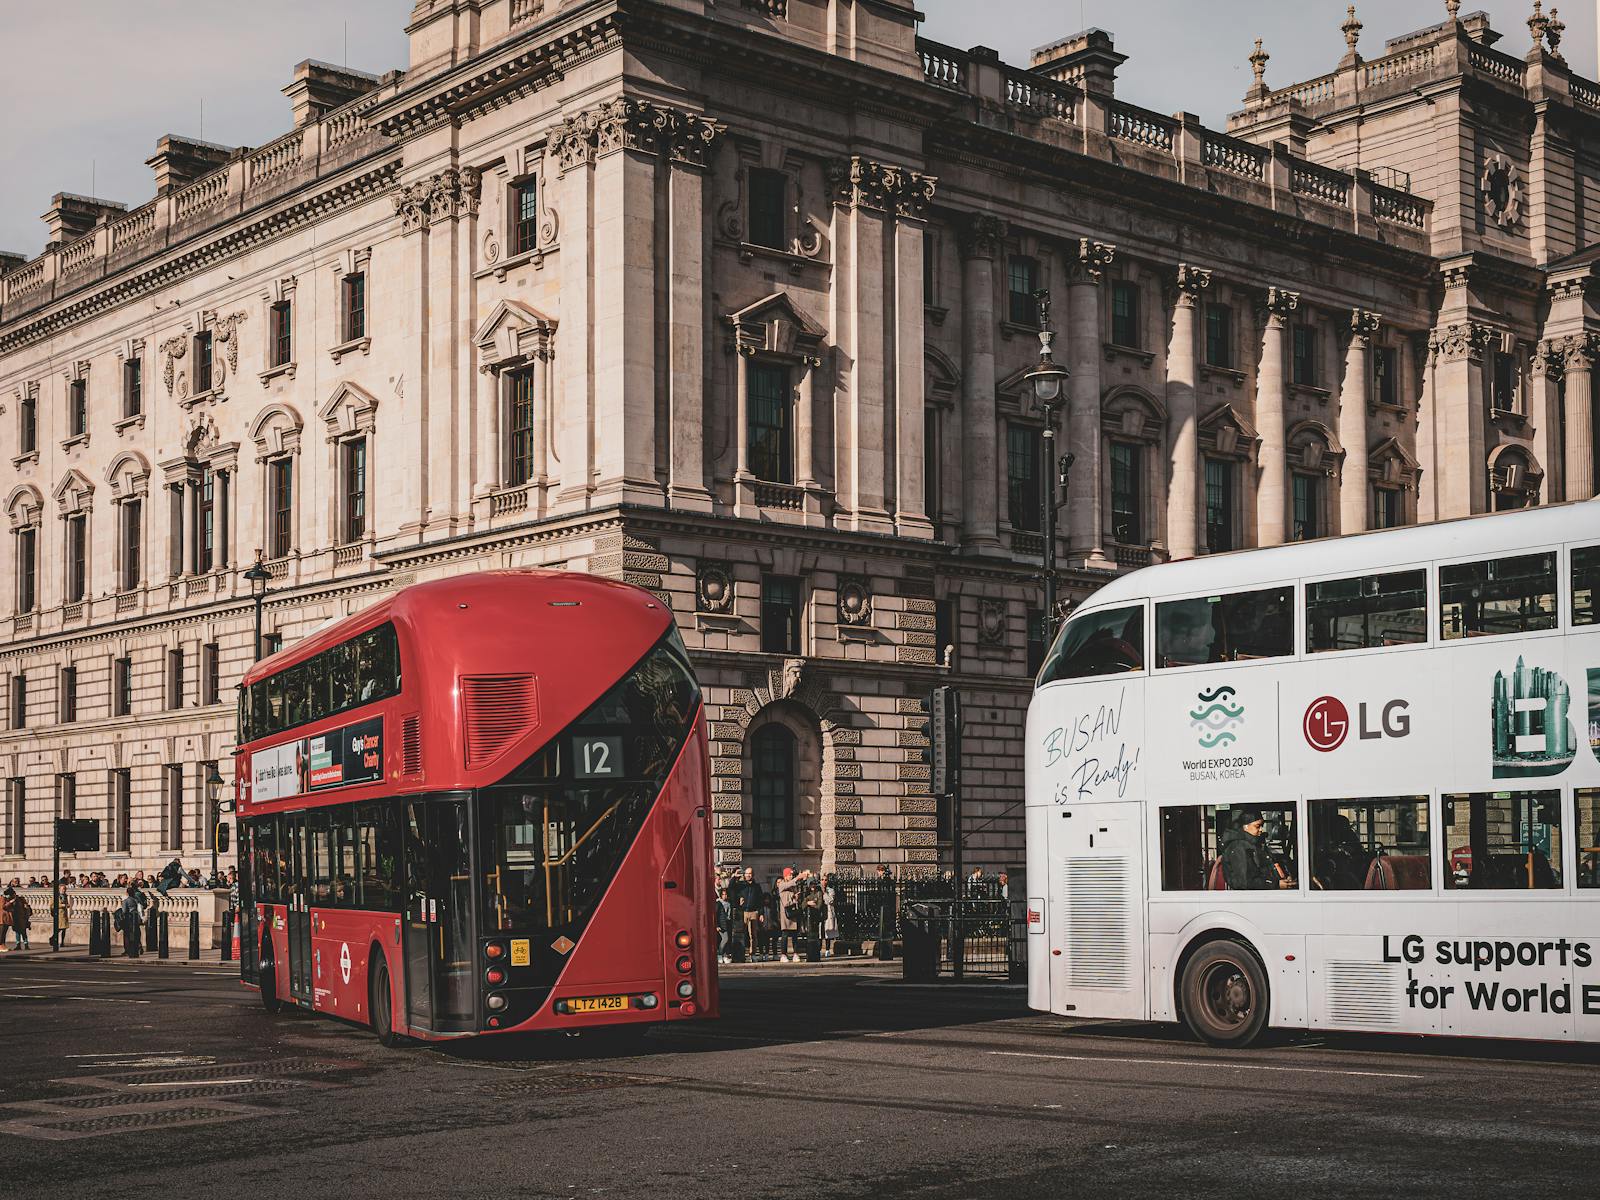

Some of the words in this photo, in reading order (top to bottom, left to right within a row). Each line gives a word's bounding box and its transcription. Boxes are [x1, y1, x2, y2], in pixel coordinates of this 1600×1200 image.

[1043, 686, 1125, 768] BUSAN
[1359, 699, 1411, 740] LG
[364, 734, 380, 749] Cancer
[583, 741, 612, 774] 12
[363, 751, 380, 770] Charity
[1055, 782, 1068, 805] is
[1071, 743, 1140, 800] Ready!
[1182, 760, 1207, 770] World
[1208, 758, 1231, 769] EXPO
[1232, 756, 1254, 767] 2030
[1190, 770, 1218, 781] BUSAN,
[1219, 769, 1246, 779] KOREA
[1383, 934, 1425, 964] LG
[1435, 938, 1592, 972] supports
[1406, 979, 1455, 1009] for
[1464, 981, 1571, 1014] World
